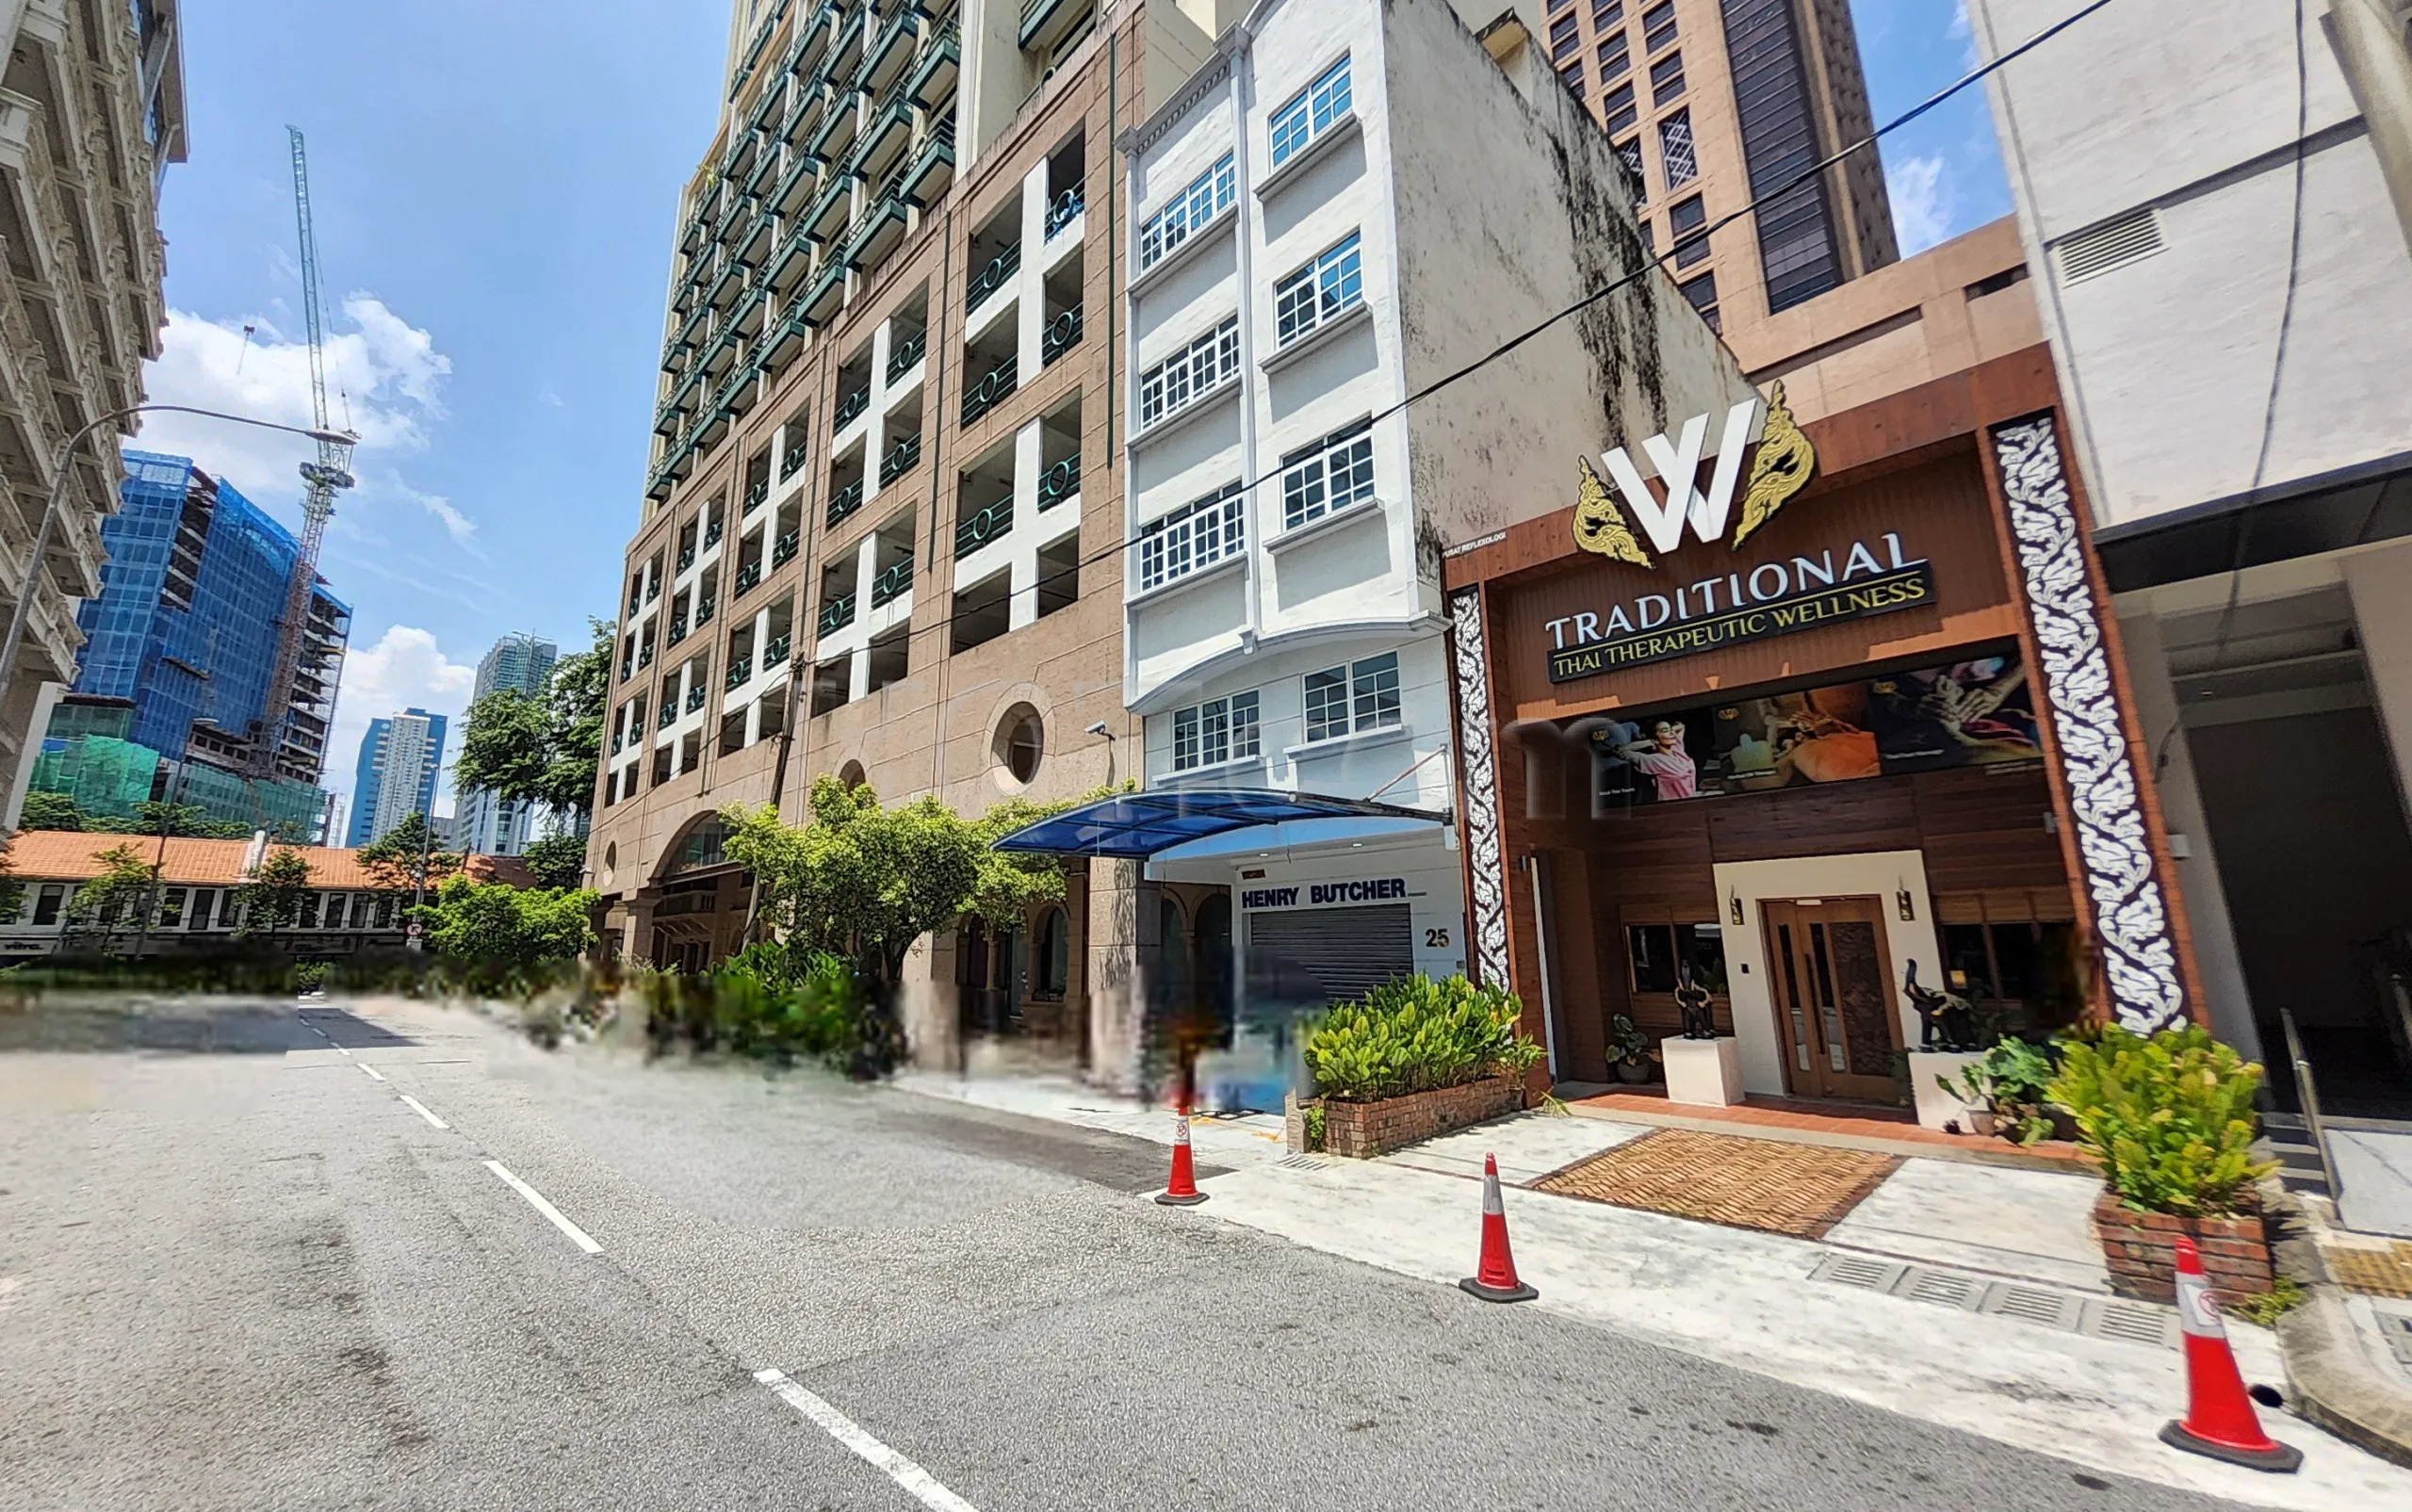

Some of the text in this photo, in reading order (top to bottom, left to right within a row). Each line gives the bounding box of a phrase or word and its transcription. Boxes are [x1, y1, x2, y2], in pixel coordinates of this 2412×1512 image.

[1461, 531, 1507, 553] REFLEXOLOGI
[1544, 532, 1930, 650] TRADITIONAL
[1554, 577, 1927, 676] THAI THERAPEUTIC WELLNESS
[1241, 878, 1407, 909] HENRY BUTCHER
[1425, 927, 1450, 948] 25
